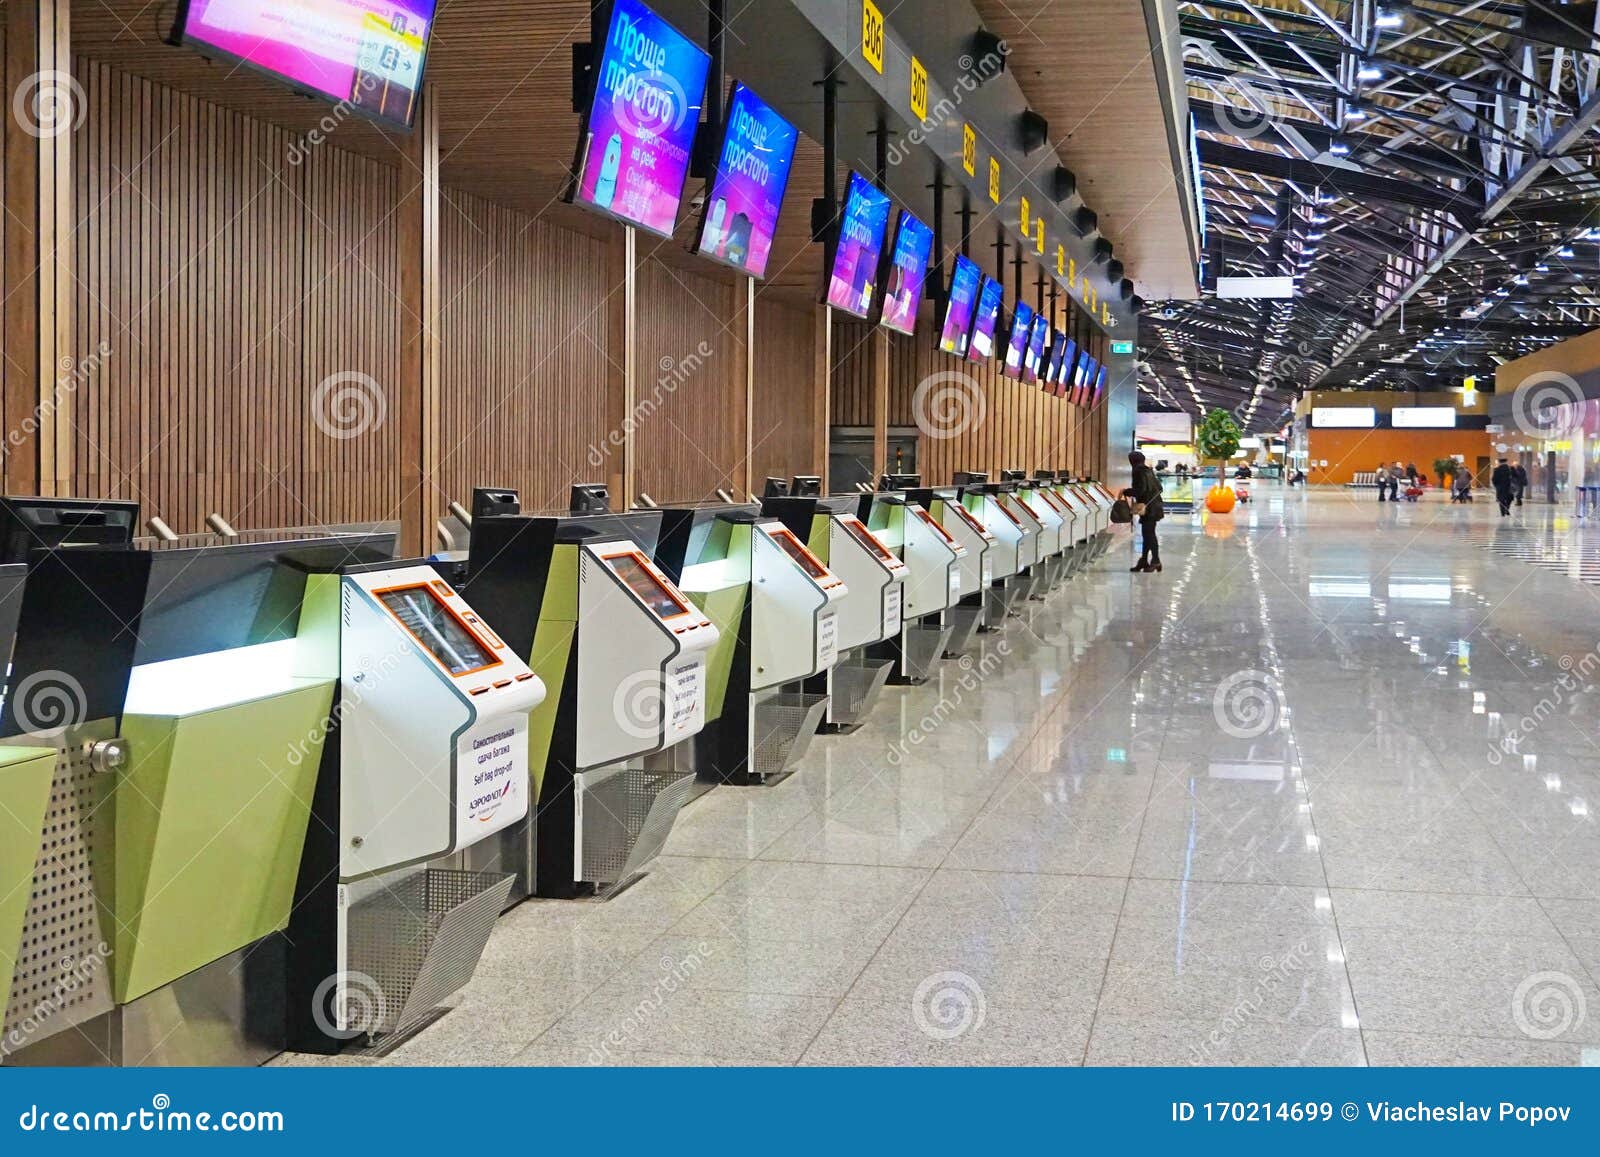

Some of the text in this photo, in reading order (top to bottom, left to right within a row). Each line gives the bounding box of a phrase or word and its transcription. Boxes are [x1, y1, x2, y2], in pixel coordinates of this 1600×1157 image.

[613, 13, 666, 77] Проще
[864, 8, 882, 61] 306
[605, 60, 673, 124] простого
[912, 68, 926, 111] 307
[724, 140, 769, 187] простого
[474, 760, 512, 786] Self bag drop-off
